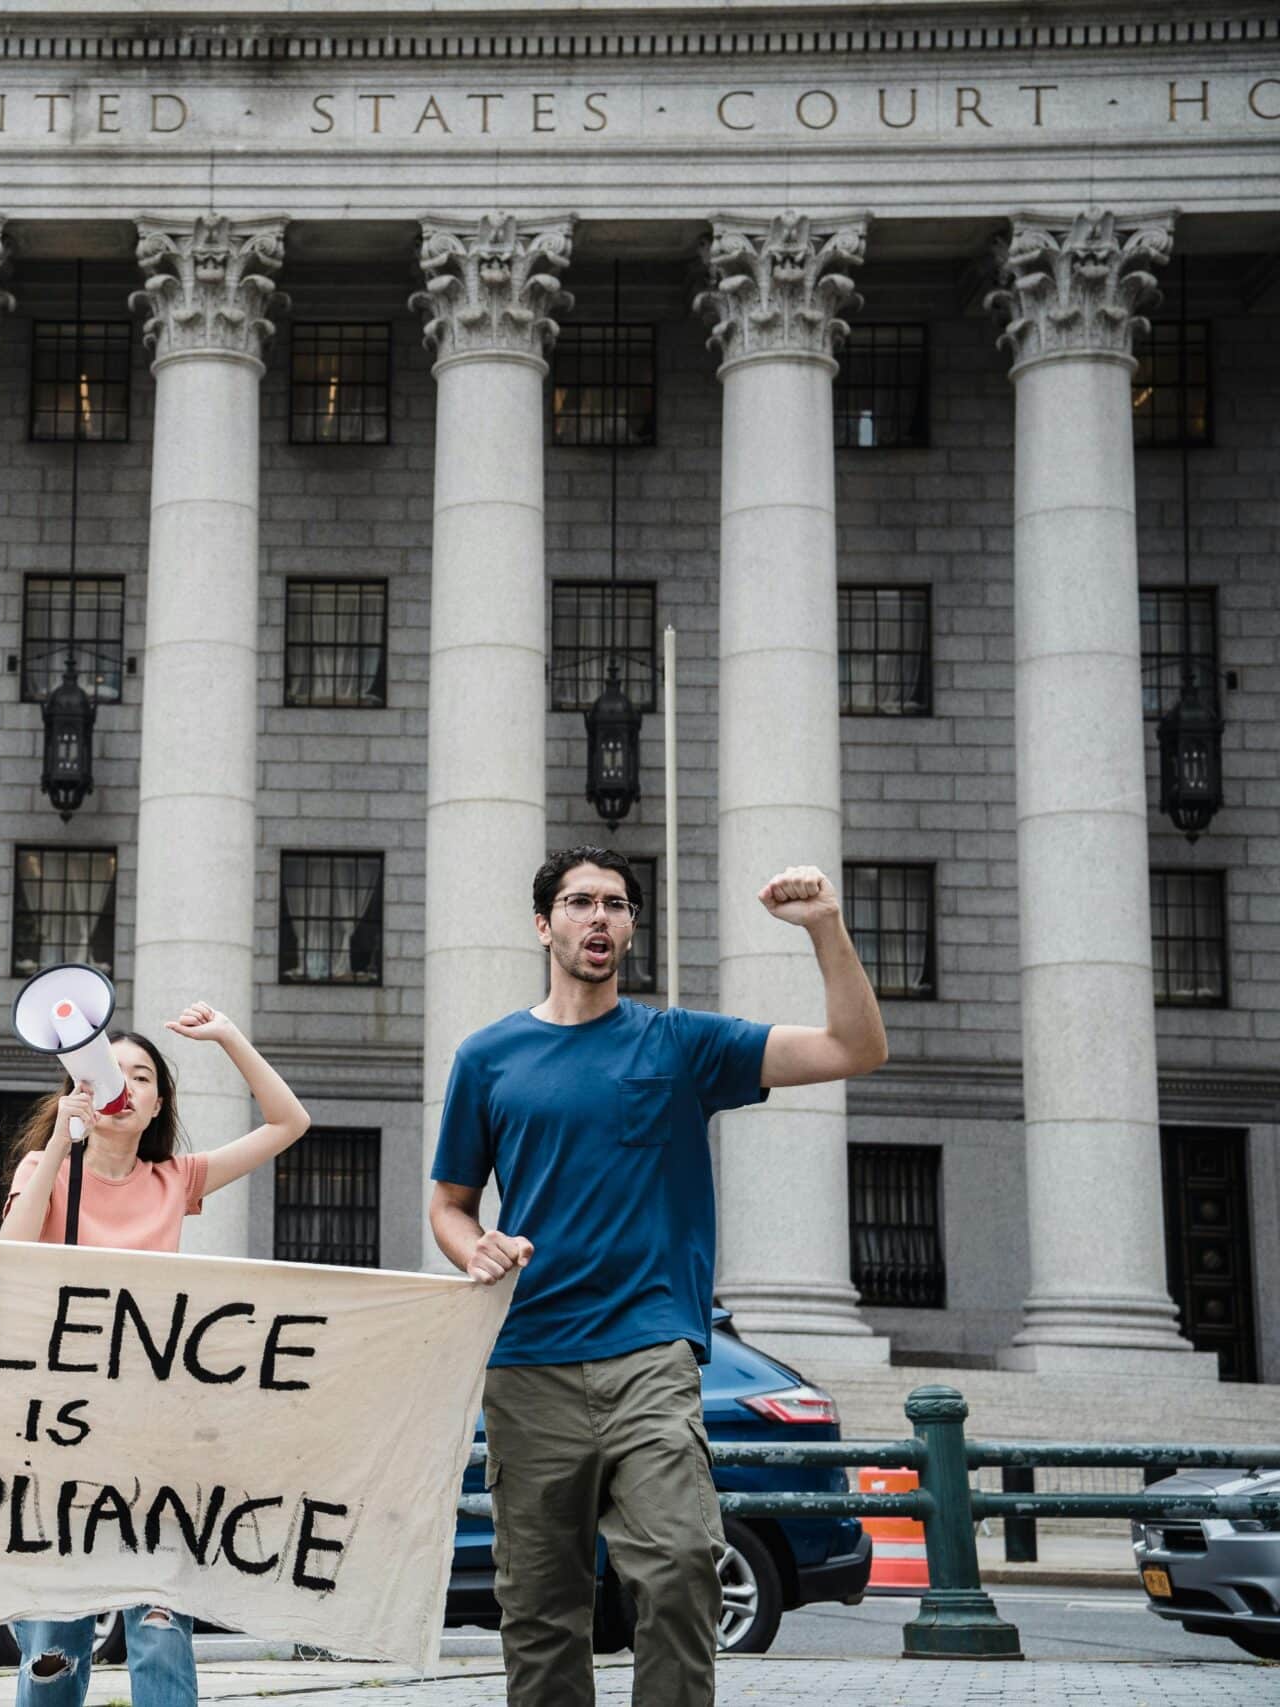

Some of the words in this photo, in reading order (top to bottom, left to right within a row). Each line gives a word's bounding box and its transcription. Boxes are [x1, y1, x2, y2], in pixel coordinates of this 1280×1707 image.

[309, 91, 609, 134] STATES
[716, 84, 1059, 131] COURT
[24, 1399, 90, 1447] IS
